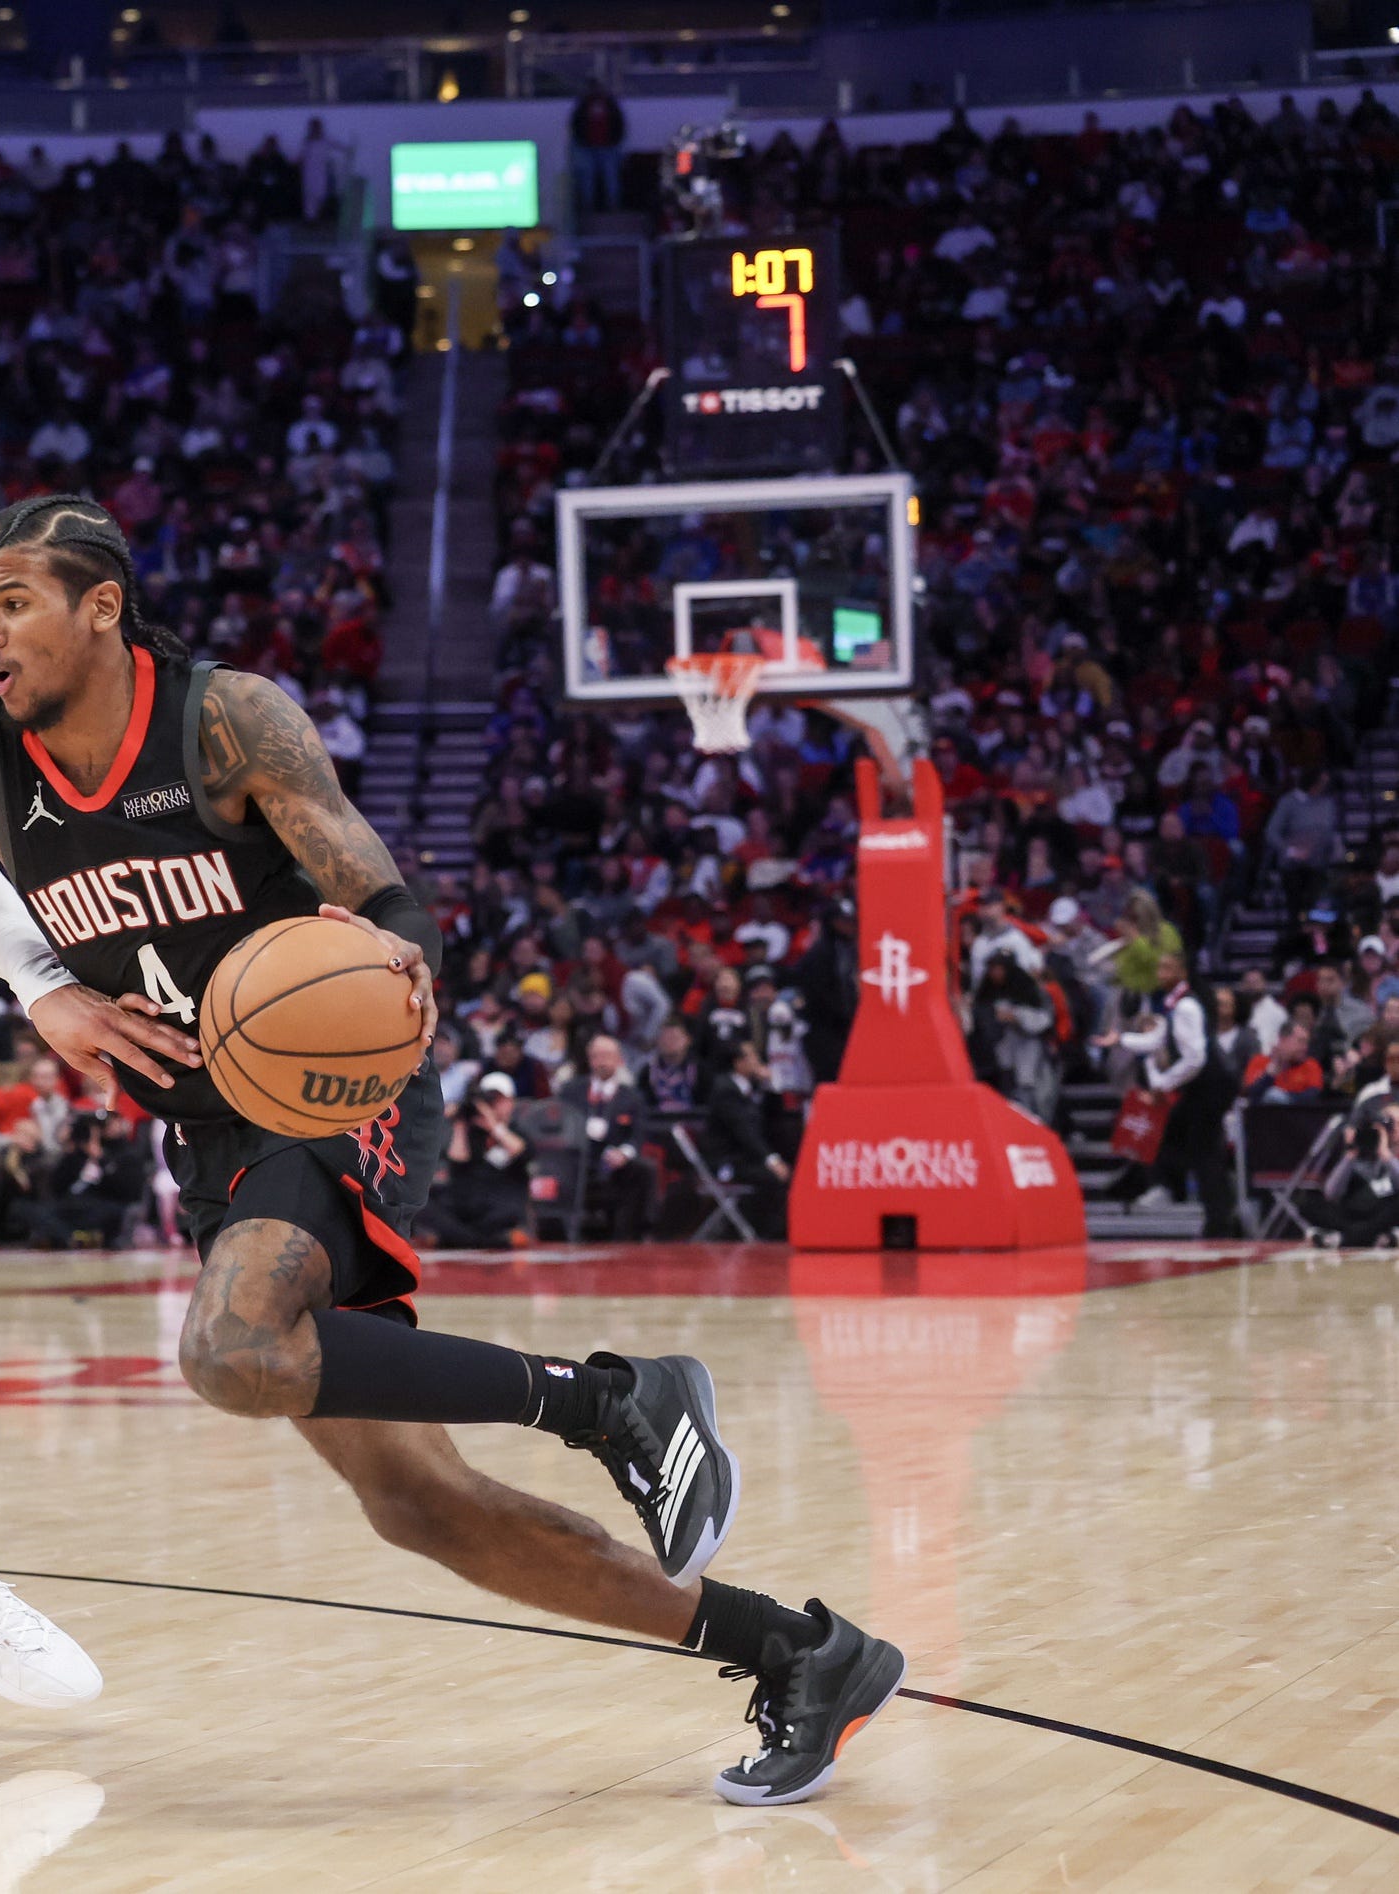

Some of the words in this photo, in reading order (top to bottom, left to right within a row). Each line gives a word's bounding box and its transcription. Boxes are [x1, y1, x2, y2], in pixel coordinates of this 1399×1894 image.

[732, 248, 813, 297] 1:07
[756, 293, 806, 372] 7
[720, 385, 825, 414] TISSOT
[123, 785, 189, 810] MEMORIAL
[124, 792, 190, 819] HERMANN
[27, 850, 246, 949] HOUSTON
[137, 943, 197, 1025] 4
[302, 1070, 411, 1107] Wilso
